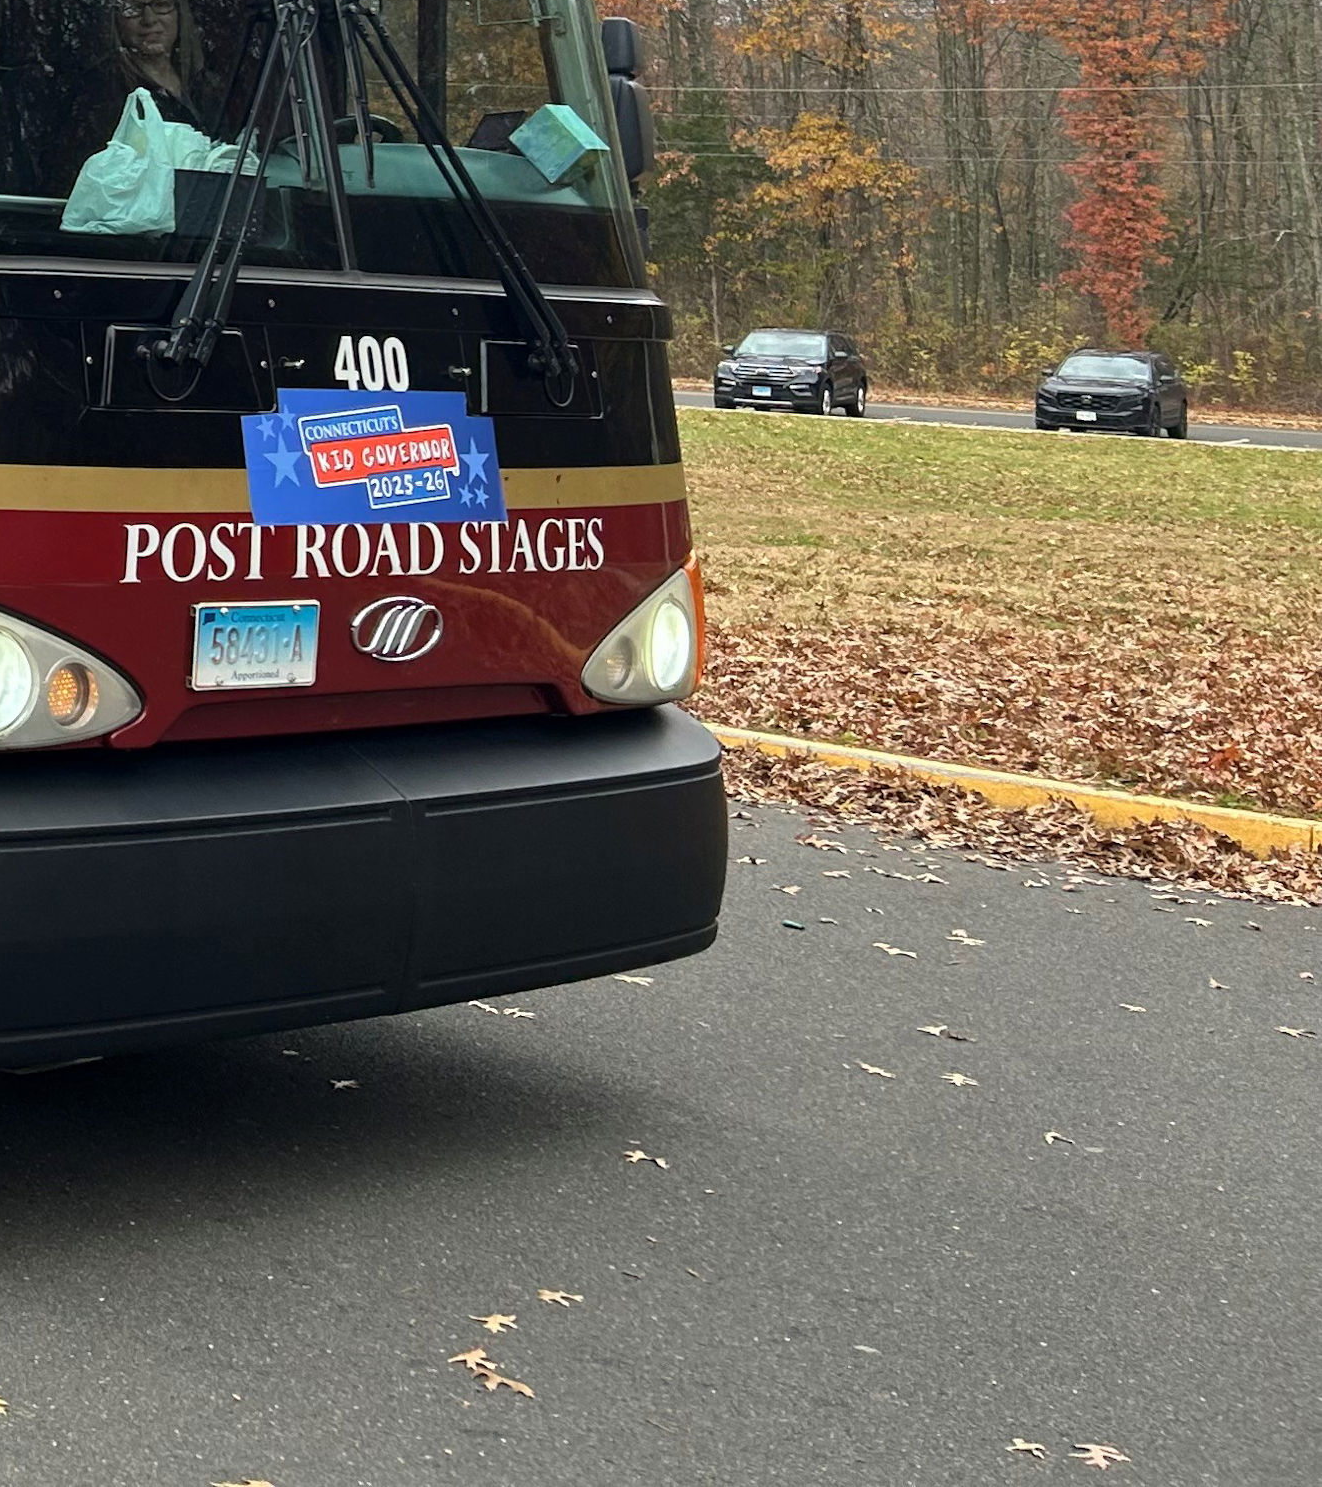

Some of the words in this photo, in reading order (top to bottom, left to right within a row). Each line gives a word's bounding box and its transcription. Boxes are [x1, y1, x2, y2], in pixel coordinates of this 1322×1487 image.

[334, 336, 409, 392] 400
[317, 449, 354, 473] KID
[362, 438, 451, 468] GOVERNOR
[370, 470, 445, 499] 2025-26
[119, 522, 275, 584] POST
[292, 522, 445, 579] ROAD
[458, 518, 605, 575] STAGES
[230, 612, 286, 623] Connecticut
[230, 669, 280, 681] Apportioned
